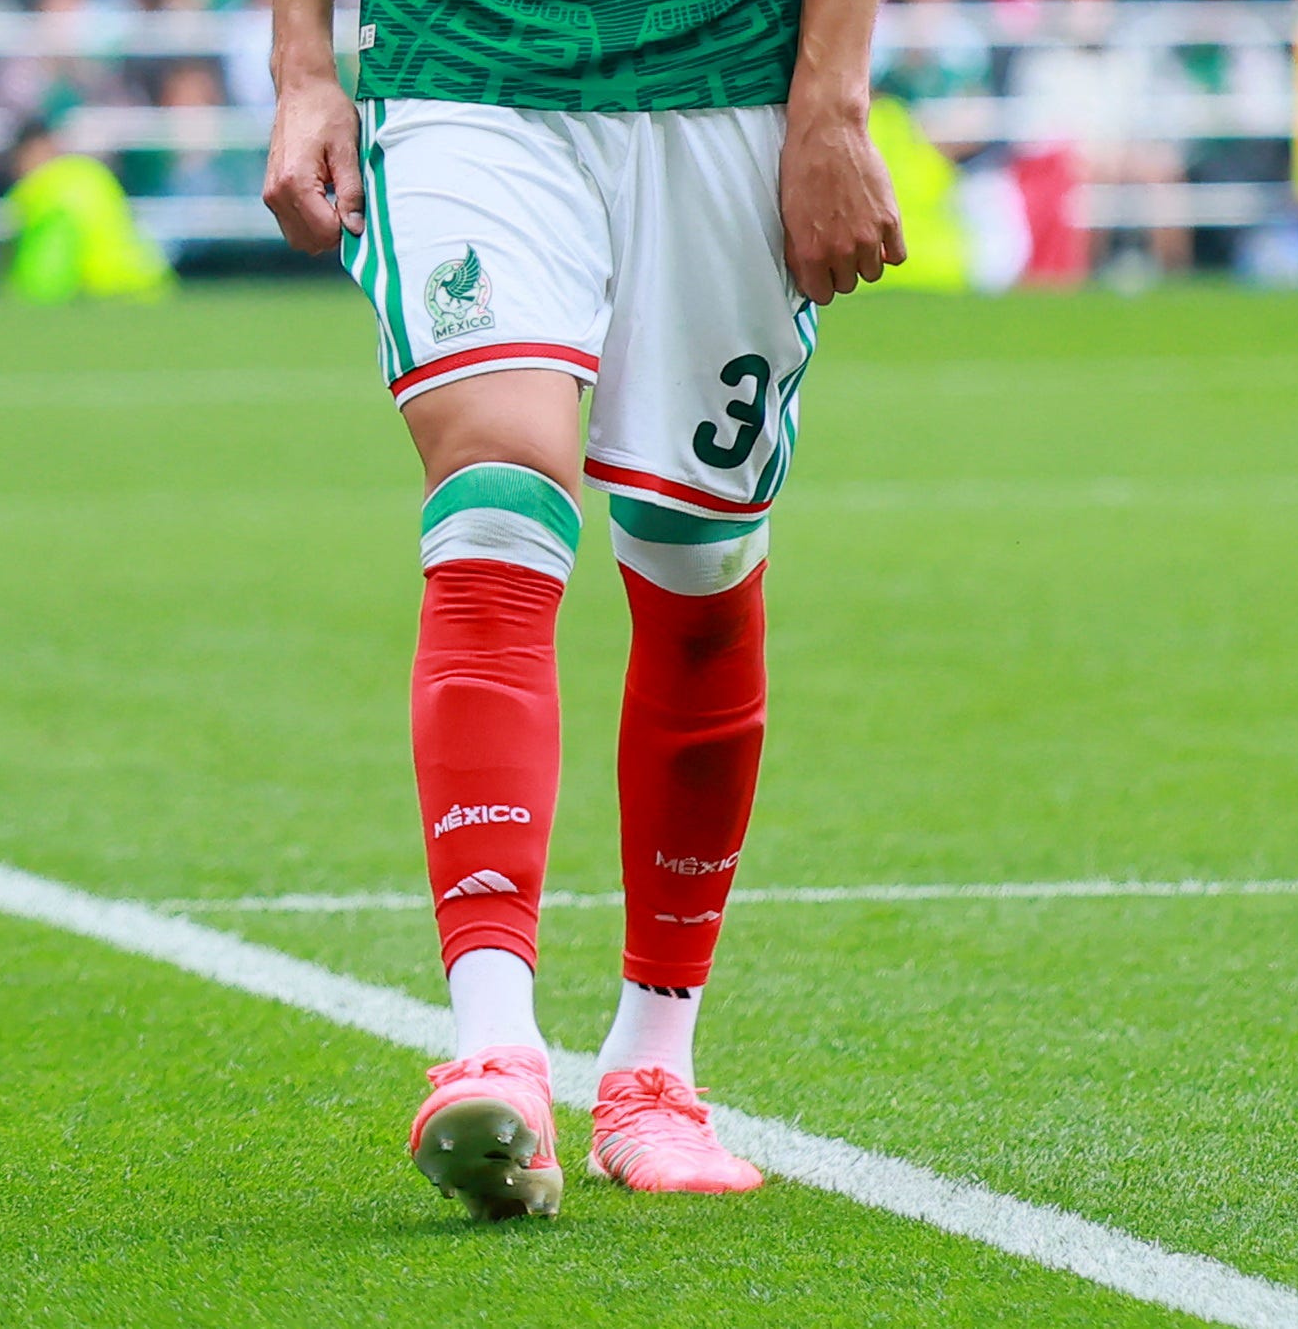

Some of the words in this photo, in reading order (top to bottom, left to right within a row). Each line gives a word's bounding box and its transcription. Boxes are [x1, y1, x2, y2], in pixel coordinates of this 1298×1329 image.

[692, 354, 771, 469] 3
[434, 803, 532, 839] MÉXICO
[655, 850, 741, 876] MÉXIC
